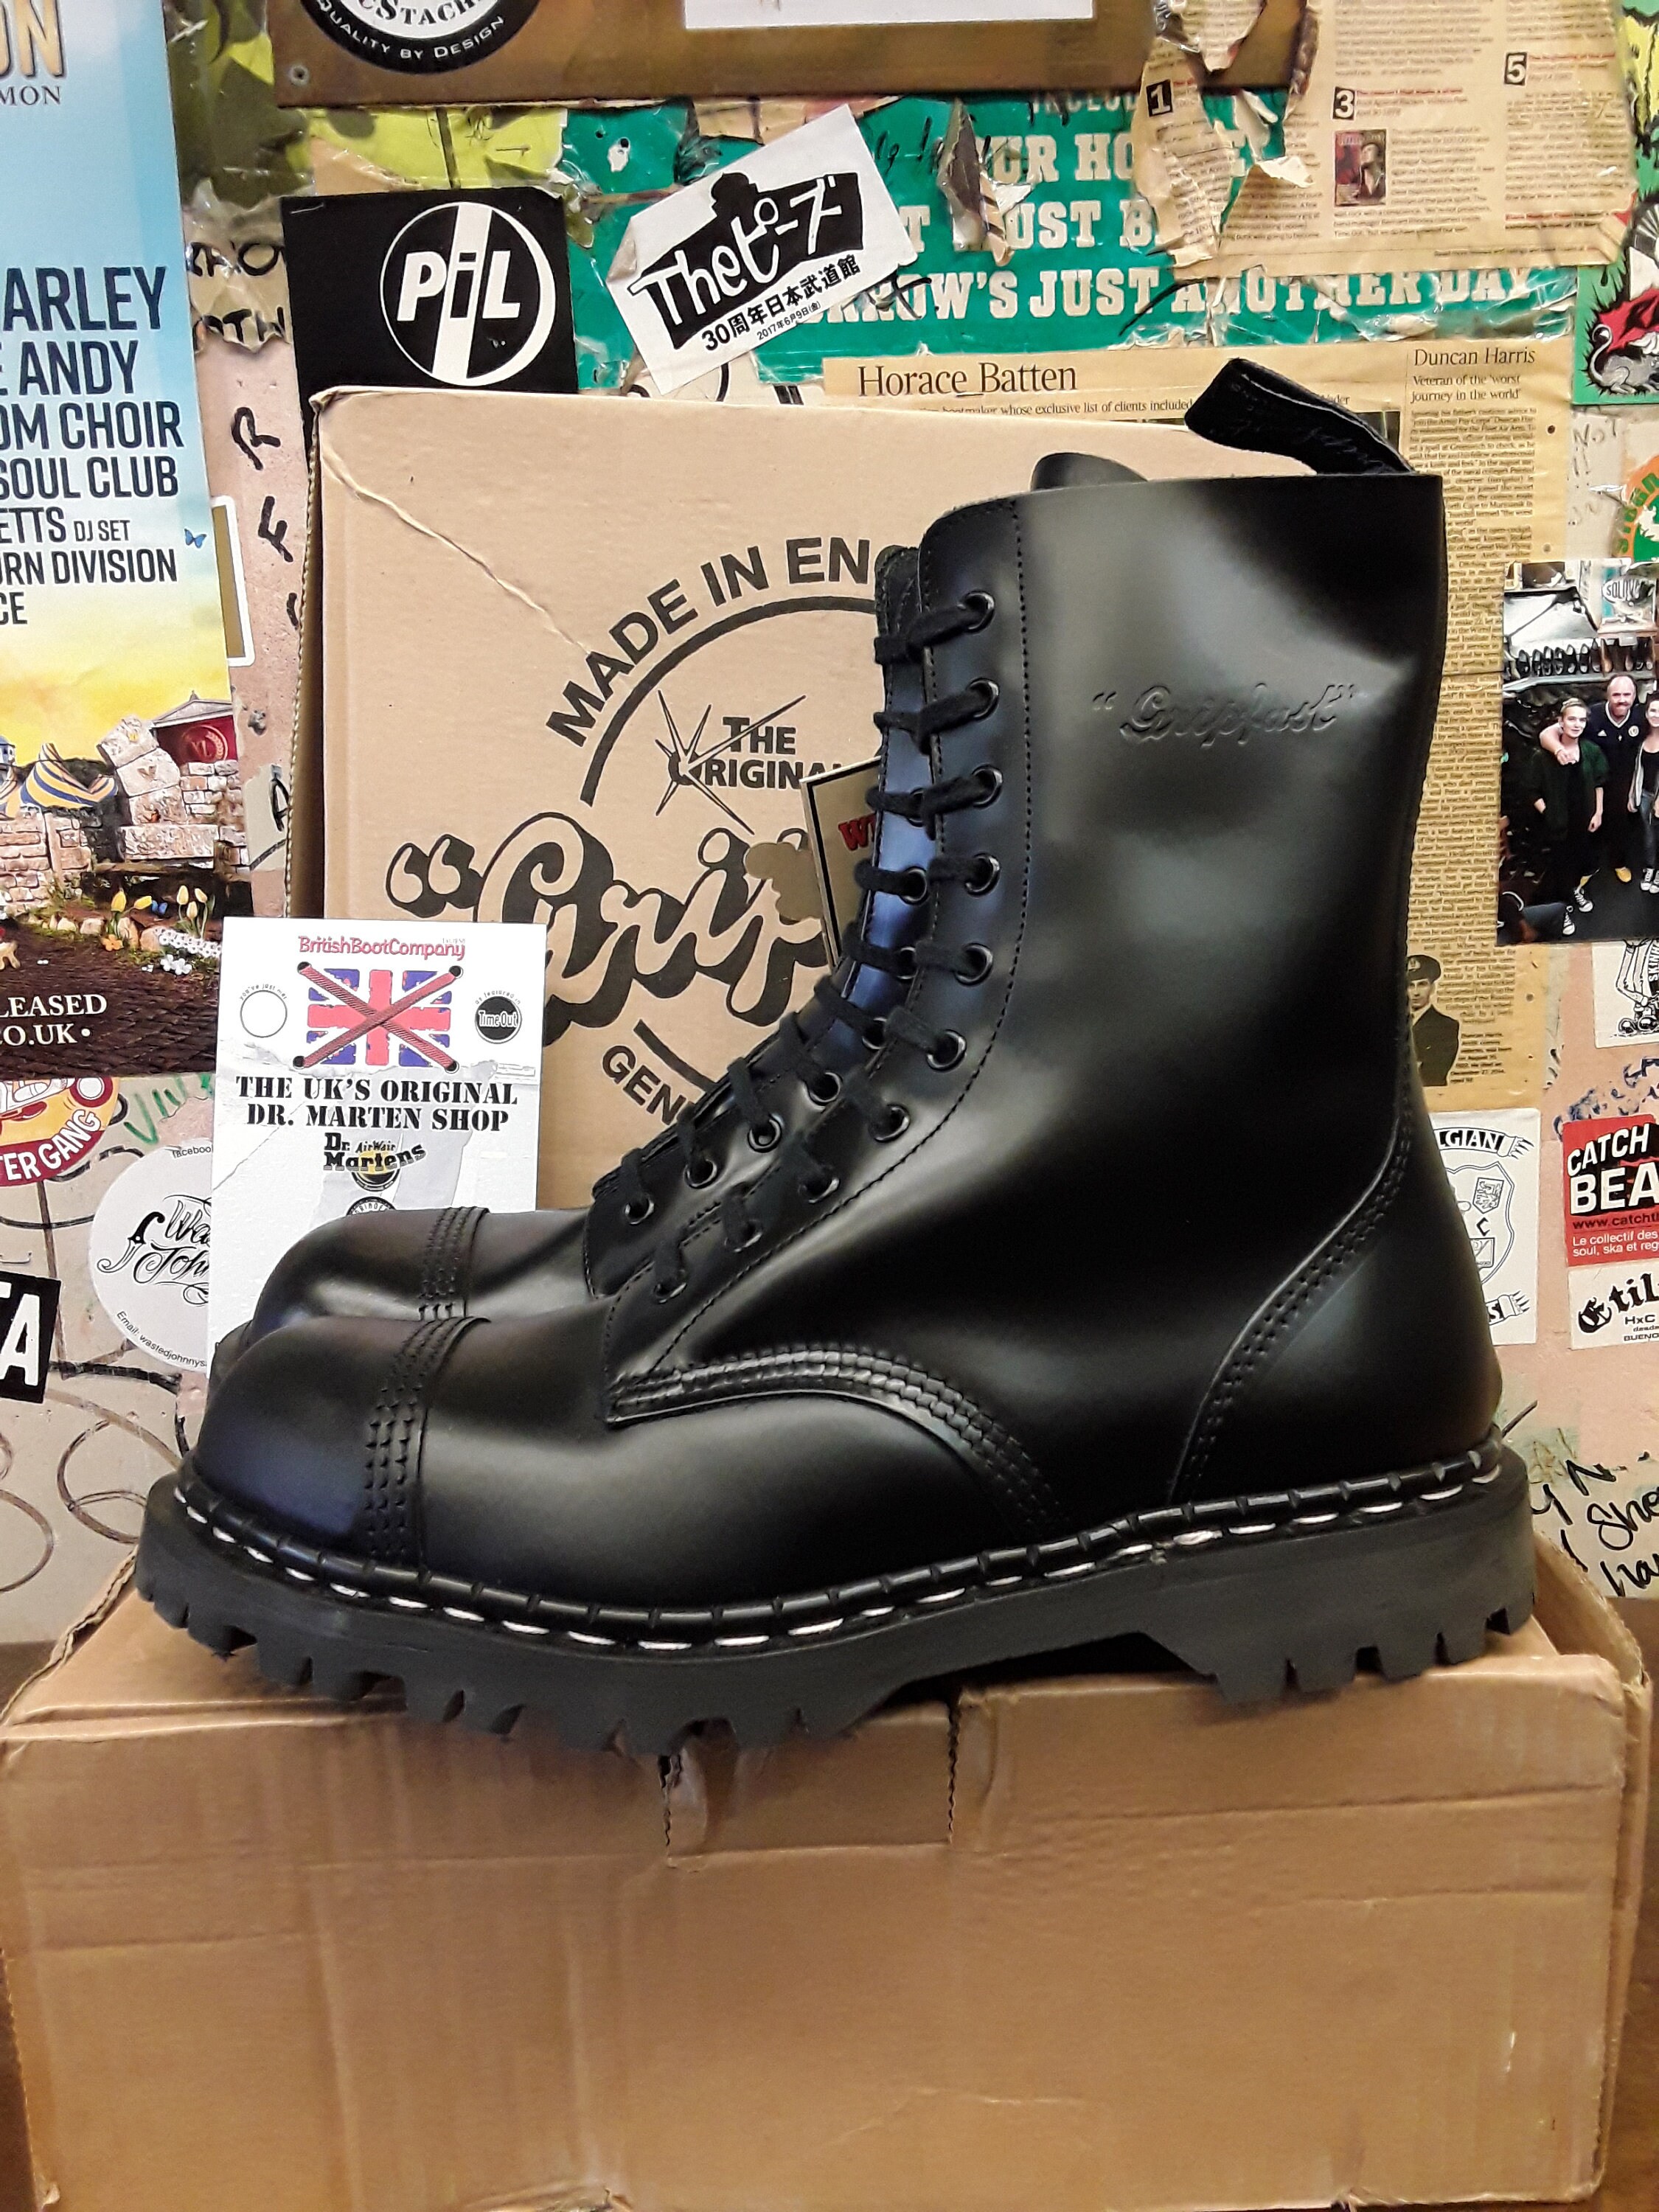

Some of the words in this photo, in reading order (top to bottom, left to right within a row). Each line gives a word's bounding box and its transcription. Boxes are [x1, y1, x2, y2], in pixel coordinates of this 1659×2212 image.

[400, 49, 423, 59] BY
[434, 15, 505, 58] DESIGN
[1507, 55, 1526, 83] 5
[1150, 83, 1171, 115] 1
[1335, 89, 1354, 118] 3
[963, 200, 1102, 251] UST
[397, 250, 521, 322] PiL
[1030, 268, 1158, 319] JUST
[701, 254, 861, 352] 30周年日本武道館
[18, 339, 139, 397] ANDY
[1414, 348, 1478, 366] Duncan
[1484, 346, 1536, 365] Harris
[858, 365, 968, 397] Horace
[978, 362, 1078, 394] Batten
[1413, 375, 1453, 386] Veteran
[1455, 375, 1467, 385] of
[1470, 375, 1487, 385] the
[1456, 391, 1466, 400] in
[1470, 389, 1487, 400] the
[1001, 404, 1032, 414] whose
[1036, 403, 1081, 414] exclusive
[1084, 401, 1099, 412] list
[1102, 400, 1114, 411] of
[1115, 400, 1147, 411] clients
[1150, 398, 1193, 411] included
[59, 400, 184, 450] CHOIR
[86, 455, 179, 499] CLUB
[74, 520, 94, 543] DJ
[98, 519, 131, 542] SET
[52, 548, 178, 585] DIVISION
[546, 578, 699, 748] MADE
[700, 545, 769, 607] IN
[723, 715, 796, 756] THE
[668, 748, 833, 790] ORIGIN
[298, 936, 466, 961] BritishBootCompany
[236, 1076, 293, 1099] THE
[305, 1077, 371, 1101] UK'S
[380, 1079, 518, 1105] ORIGINAL
[247, 1102, 294, 1126] DR.
[306, 1105, 422, 1130] MARTEN
[431, 1108, 509, 1132] SHOP
[0, 1152, 41, 1180] ER
[39, 1109, 101, 1169] GANG
[323, 1144, 427, 1172] Martens
[324, 1132, 350, 1151] Dr.
[355, 1140, 396, 1153] AirWair
[1568, 1123, 1651, 1177] CATCH
[1573, 1237, 1587, 1247] Le
[1590, 1231, 1634, 1245] collectif
[1638, 1230, 1658, 1240] des
[1573, 1245, 1600, 1257] soul,
[1603, 1245, 1623, 1254] ska
[1627, 1243, 1638, 1251] et
[117, 1310, 139, 1337] Email:
